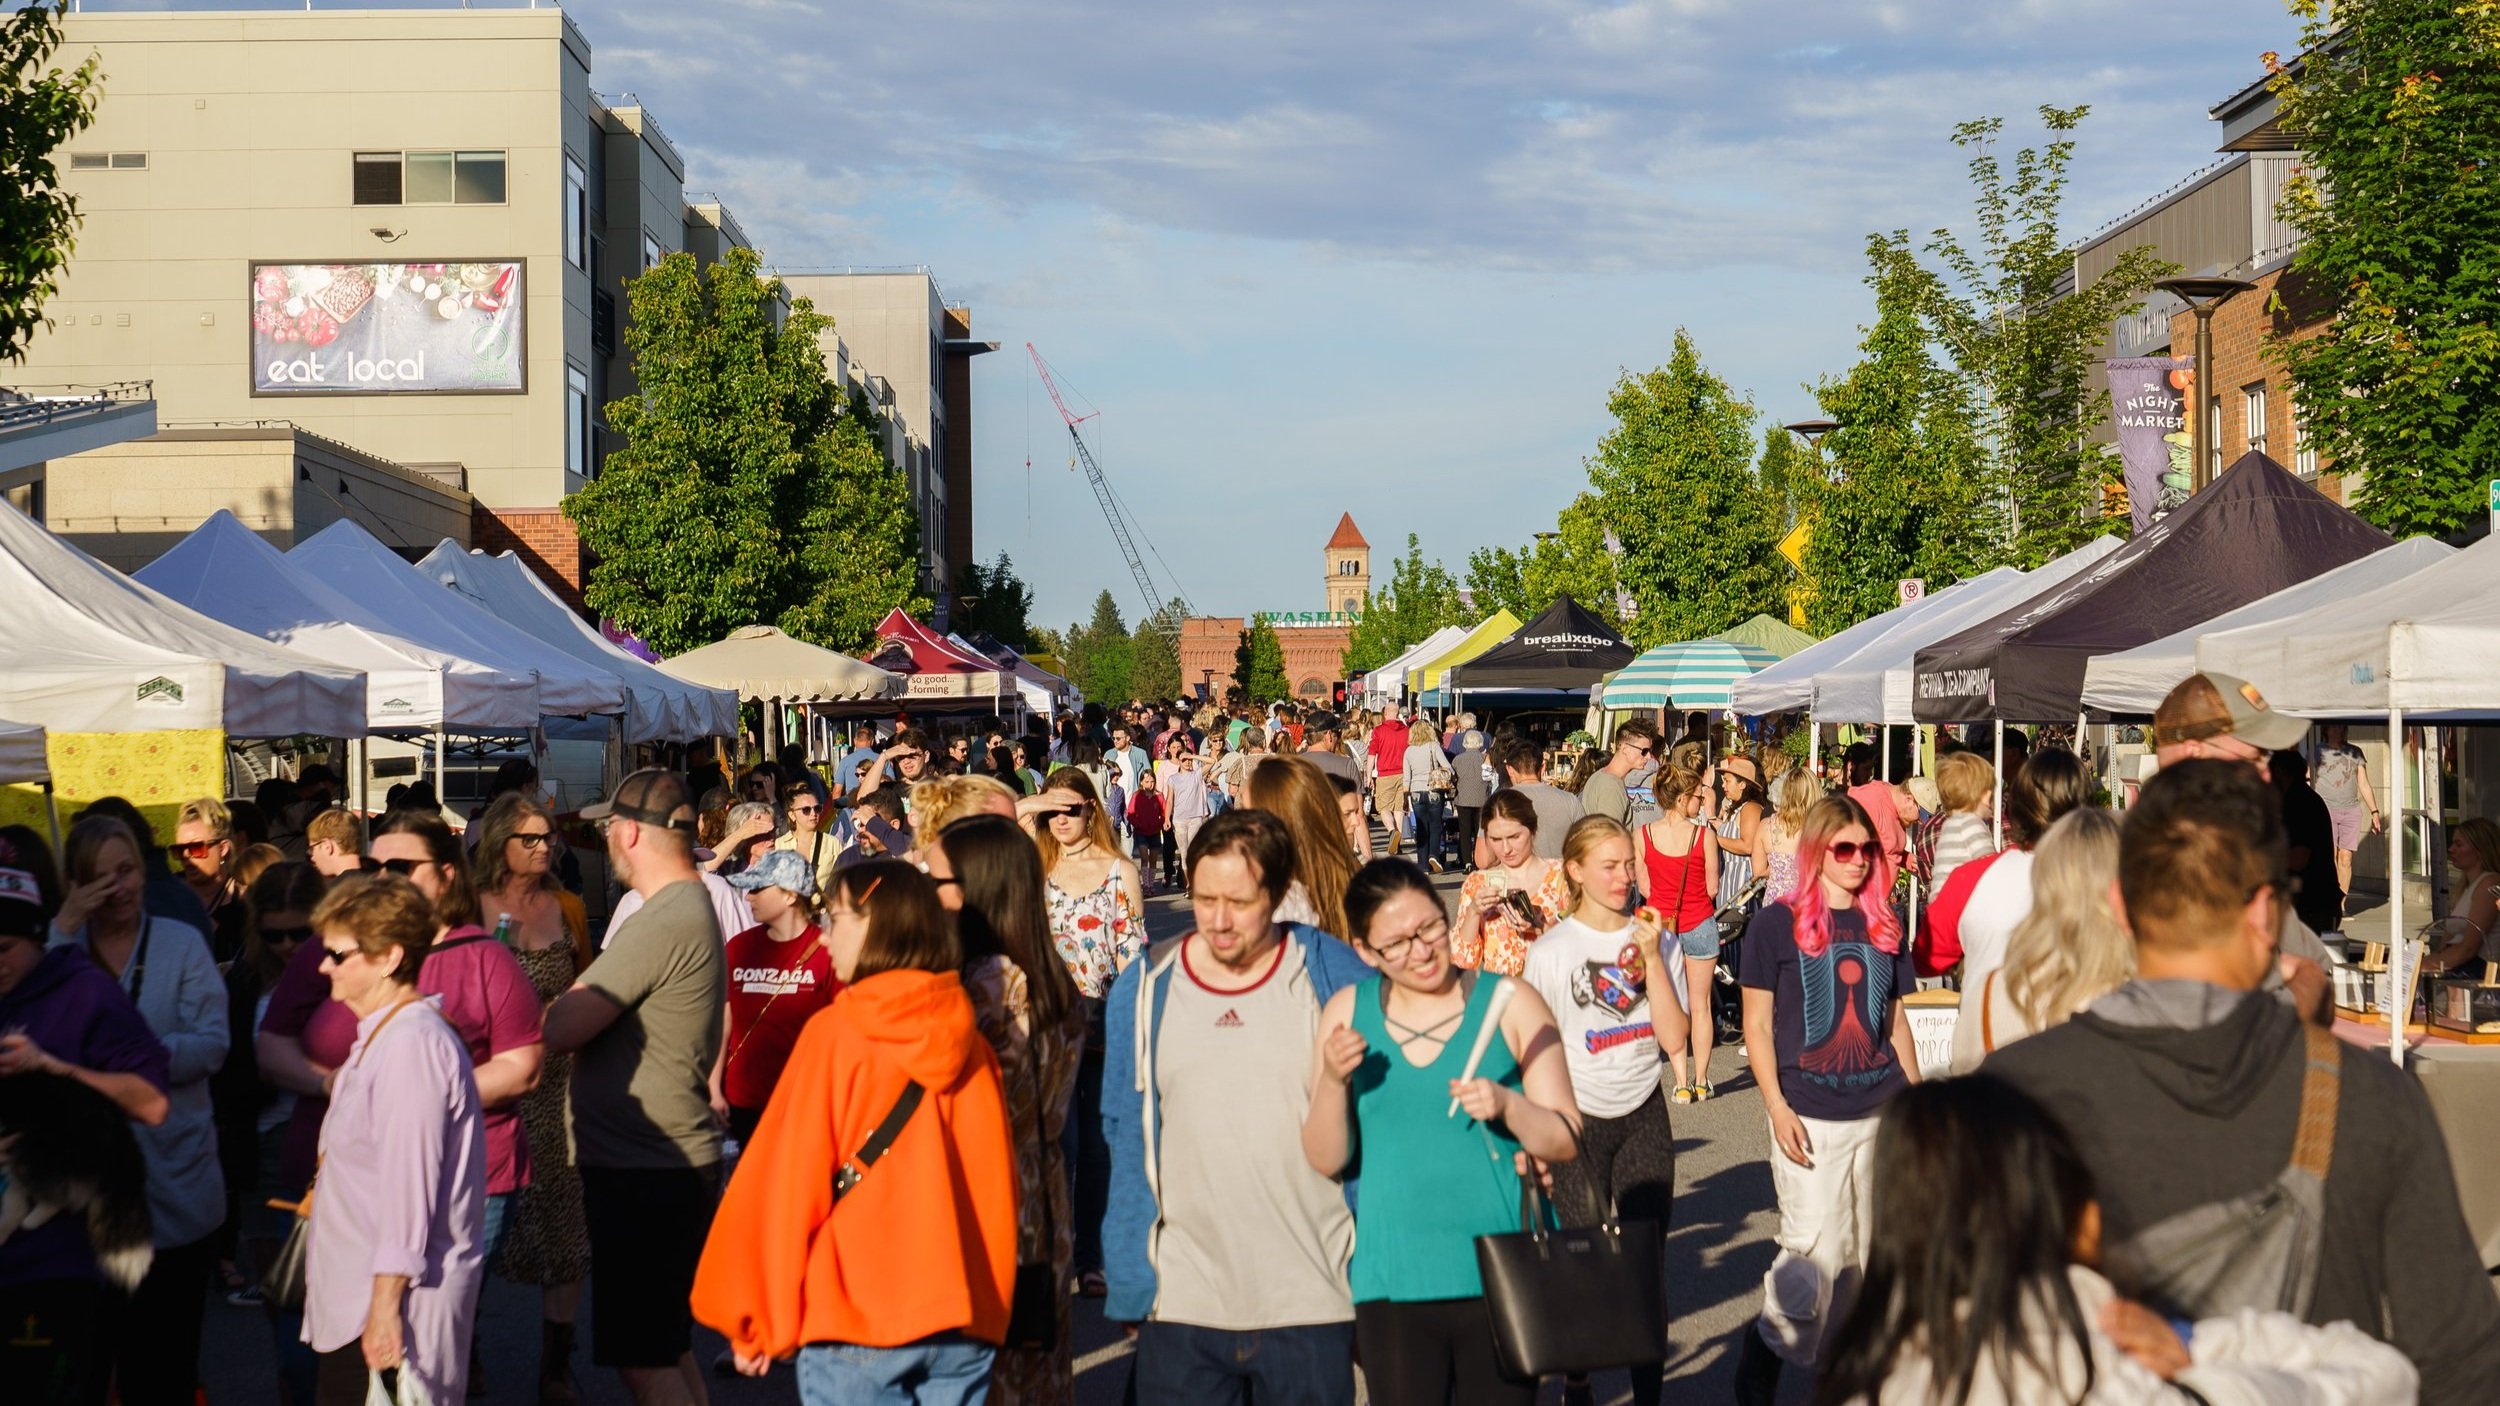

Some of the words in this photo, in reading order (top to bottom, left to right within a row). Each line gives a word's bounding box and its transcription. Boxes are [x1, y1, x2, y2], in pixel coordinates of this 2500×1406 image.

[267, 352, 325, 382] eat
[348, 350, 424, 381] local
[2143, 382, 2161, 392] The
[2126, 395, 2178, 413] NIGHT
[2121, 415, 2185, 429] MARKET
[2493, 489, 2500, 504] 9
[1261, 611, 1362, 622] WASHIN
[1919, 672, 1945, 699] REVIVAL
[1943, 670, 1959, 697] TEA
[1957, 667, 1990, 697] COMPANY
[732, 967, 816, 984] GONZAGA
